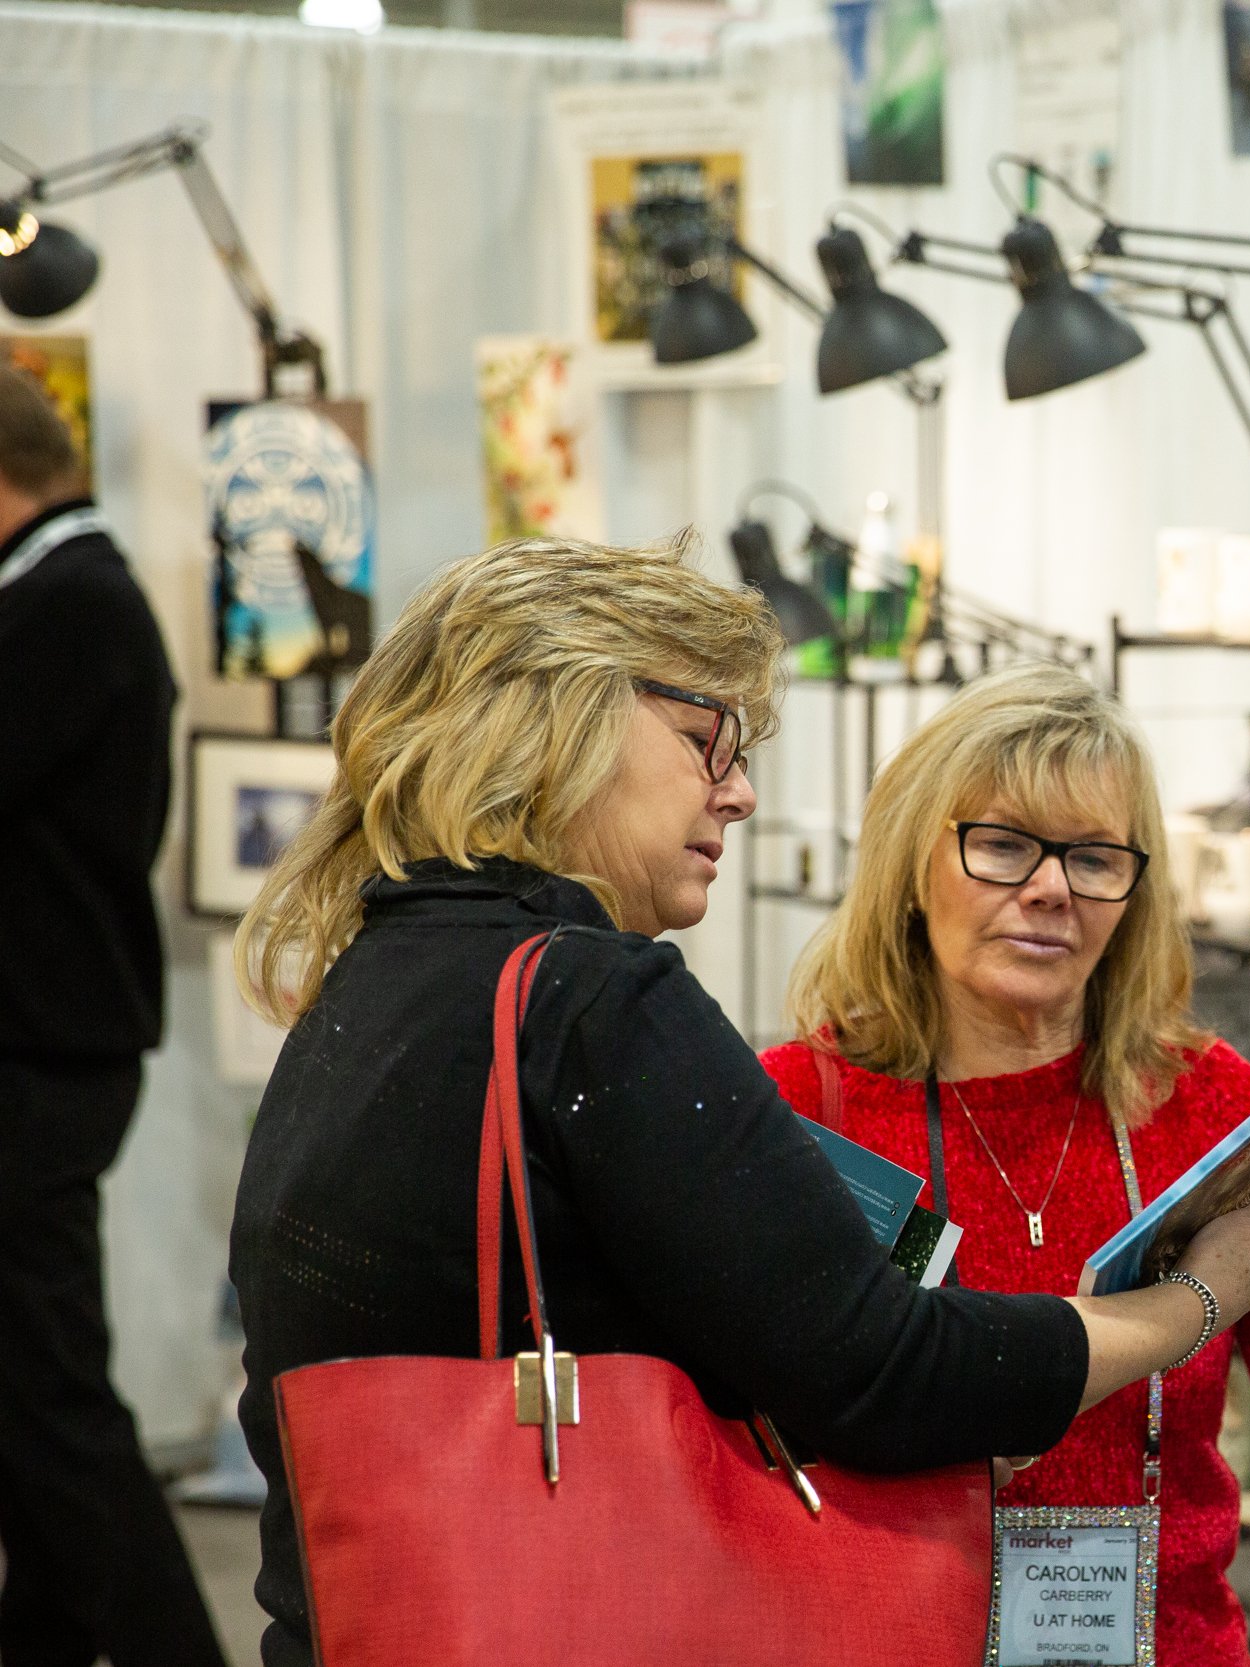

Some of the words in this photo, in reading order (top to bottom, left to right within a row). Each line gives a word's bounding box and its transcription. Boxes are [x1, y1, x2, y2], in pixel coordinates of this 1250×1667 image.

[1009, 1532, 1073, 1549] market
[1025, 1564, 1127, 1582] CAROLYNN
[1039, 1589, 1112, 1602] CARBERRY
[1033, 1614, 1044, 1627] U
[1048, 1614, 1068, 1627] AT
[1071, 1614, 1116, 1627] HOME
[1094, 1643, 1110, 1653] ON
